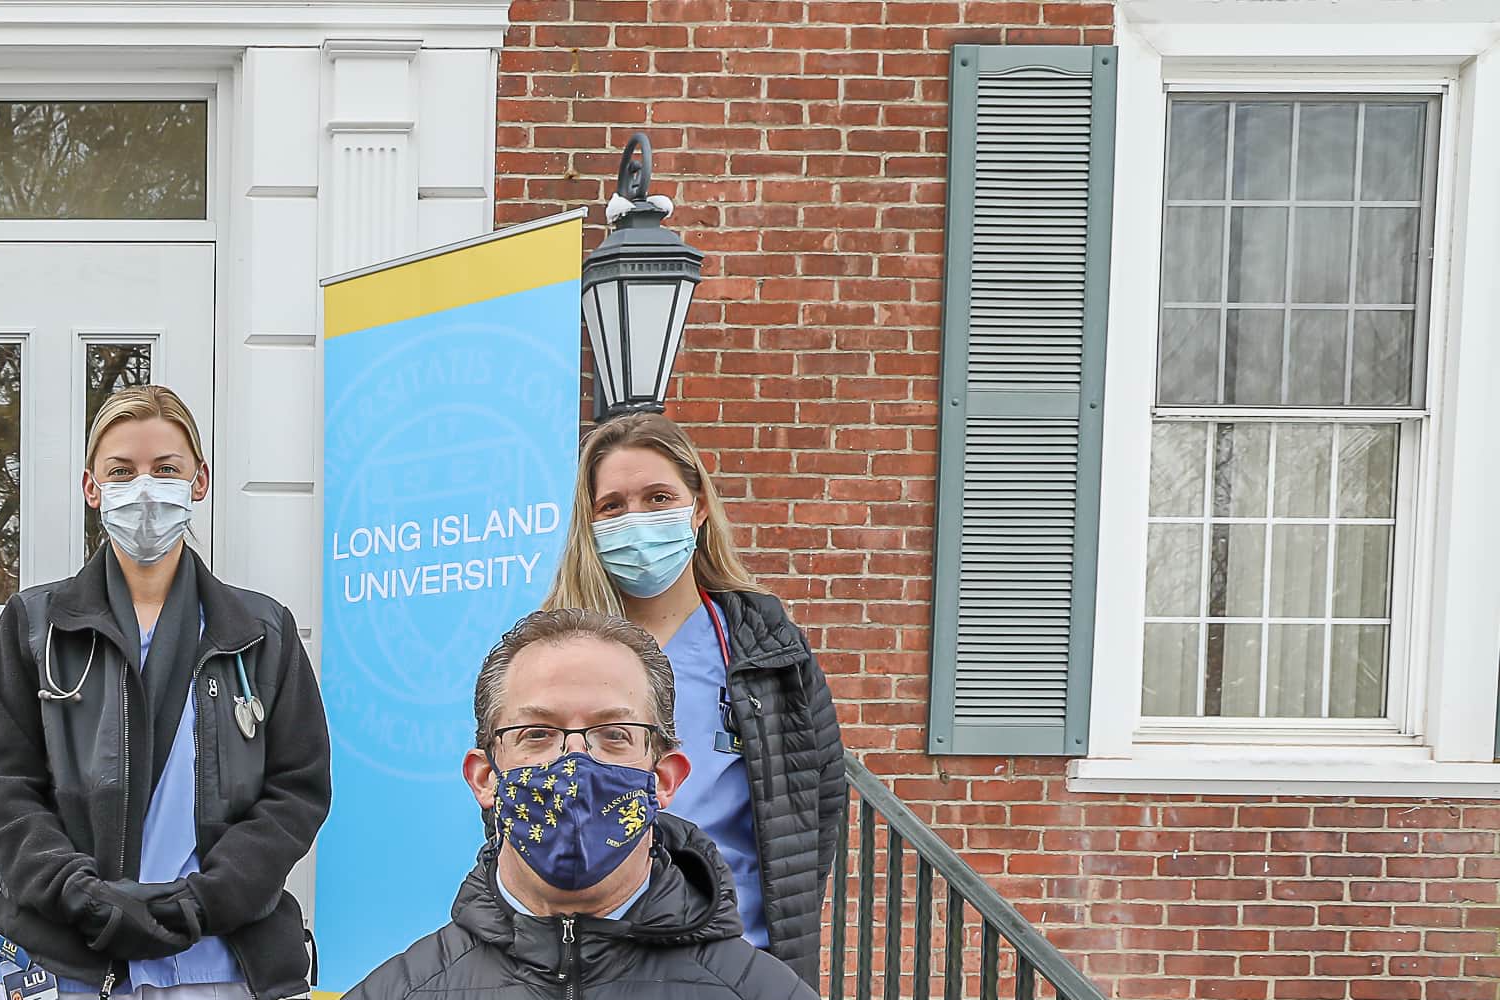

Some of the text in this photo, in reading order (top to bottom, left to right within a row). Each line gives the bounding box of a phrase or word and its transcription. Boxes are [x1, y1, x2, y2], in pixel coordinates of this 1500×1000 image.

[333, 502, 561, 561] LONG ISLAND
[344, 552, 542, 603] UNIVERSITY
[3, 939, 18, 953] LIU
[23, 970, 47, 988] LIU
